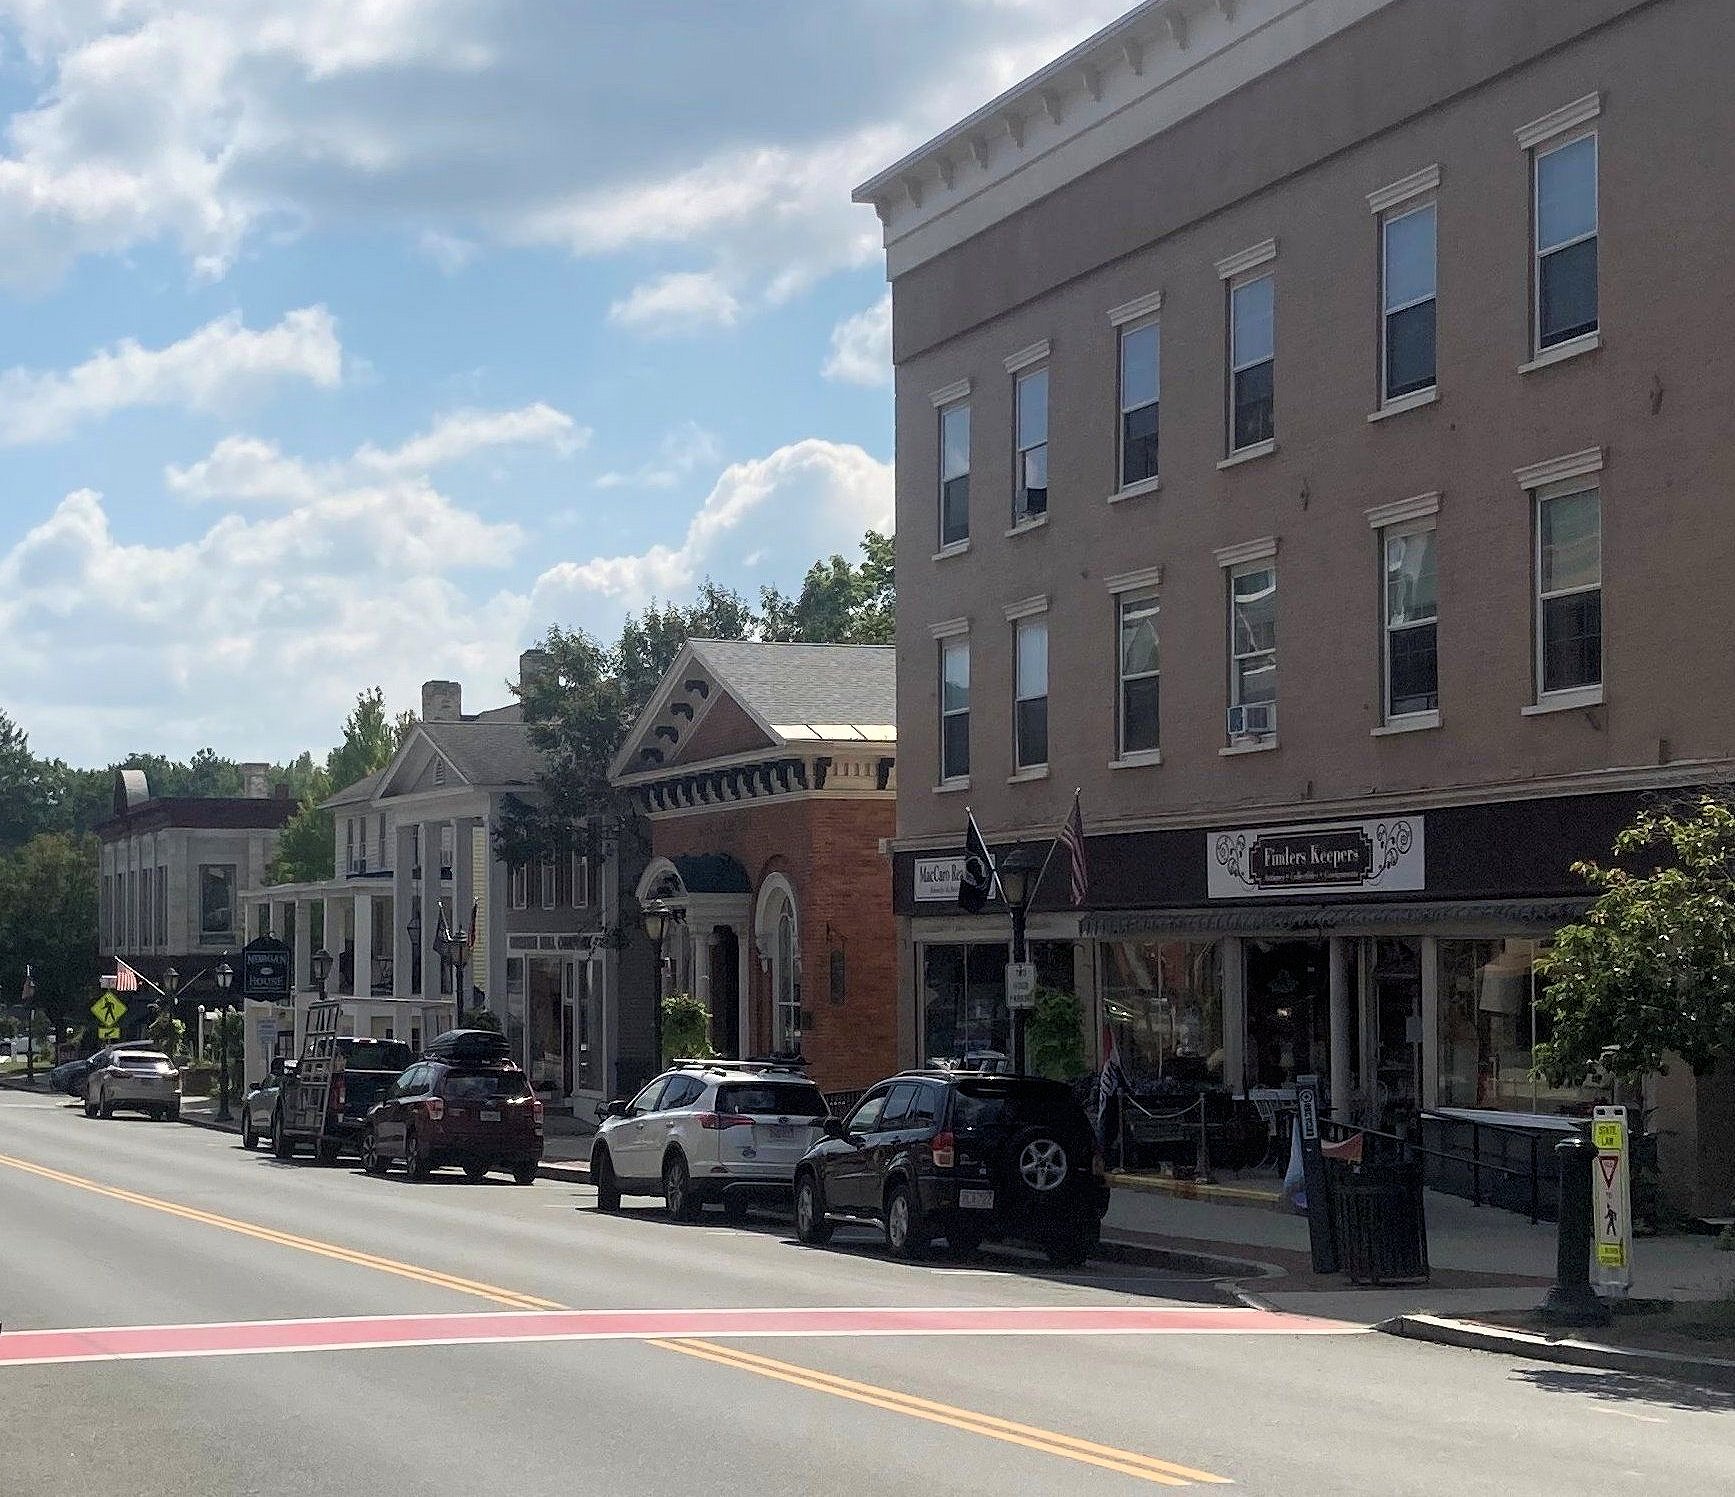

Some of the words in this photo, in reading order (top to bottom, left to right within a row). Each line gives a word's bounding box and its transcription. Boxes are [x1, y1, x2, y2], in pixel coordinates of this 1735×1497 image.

[1265, 846, 1307, 867] Finders
[1310, 844, 1359, 868] Keepers
[249, 975, 283, 987] HOUSE
[1599, 1125, 1618, 1135] STATE
[1601, 1136, 1614, 1146] LAW
